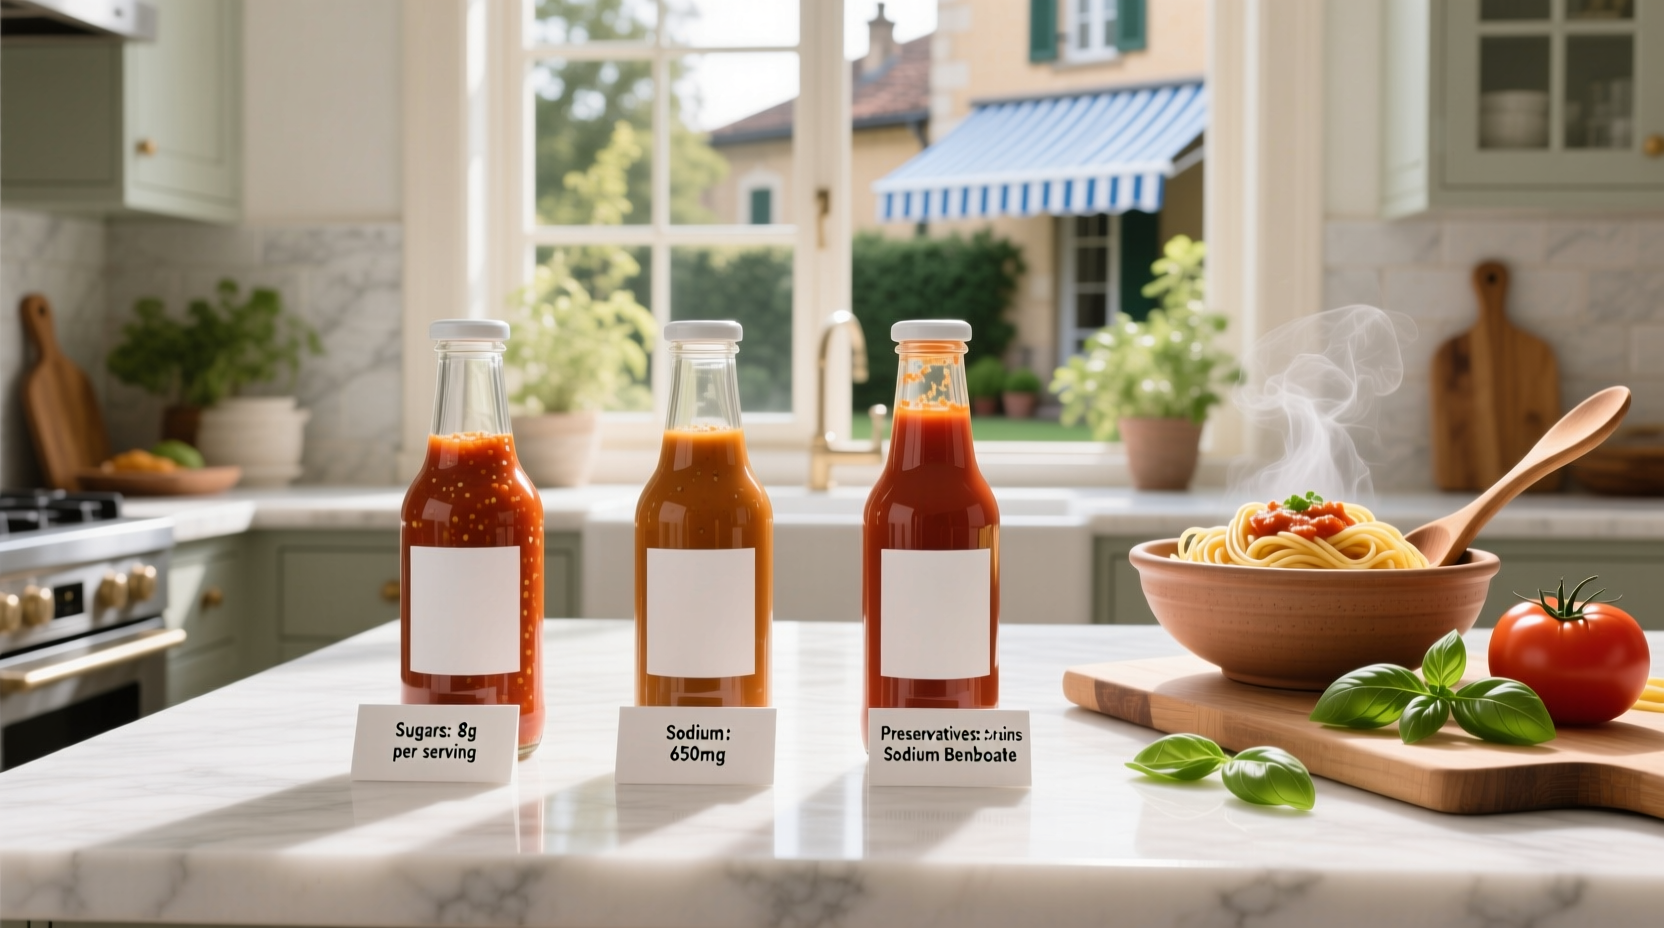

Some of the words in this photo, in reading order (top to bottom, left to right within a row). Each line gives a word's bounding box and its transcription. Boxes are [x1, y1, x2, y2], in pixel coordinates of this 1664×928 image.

[395, 721, 452, 742] Sugars:
[457, 721, 477, 742] 8g
[666, 723, 731, 741] Sodium:
[880, 725, 981, 742] Preservatives:
[392, 746, 418, 763] per
[422, 743, 477, 763] serving
[669, 745, 726, 767] 650mg
[883, 745, 940, 762] Sodium
[944, 745, 1017, 763] Benboate
